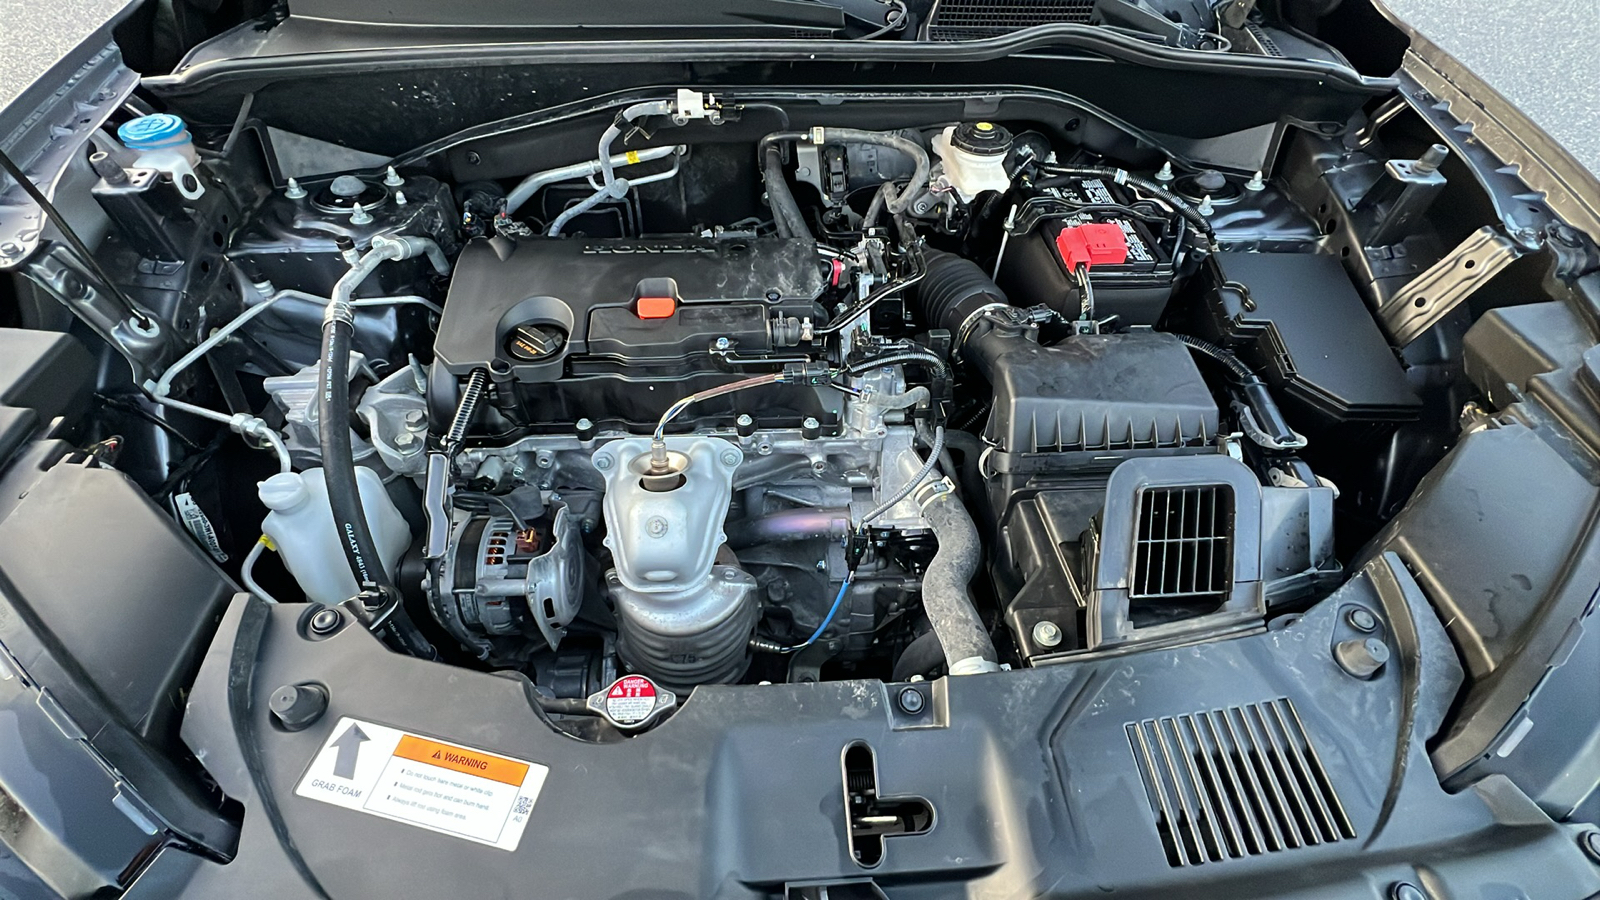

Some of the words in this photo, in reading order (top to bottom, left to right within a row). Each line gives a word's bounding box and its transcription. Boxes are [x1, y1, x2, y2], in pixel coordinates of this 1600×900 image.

[345, 523, 361, 554] GALAXY
[444, 752, 488, 770] WARNING
[311, 779, 336, 792] GRAB
[336, 785, 362, 798] FOAM
